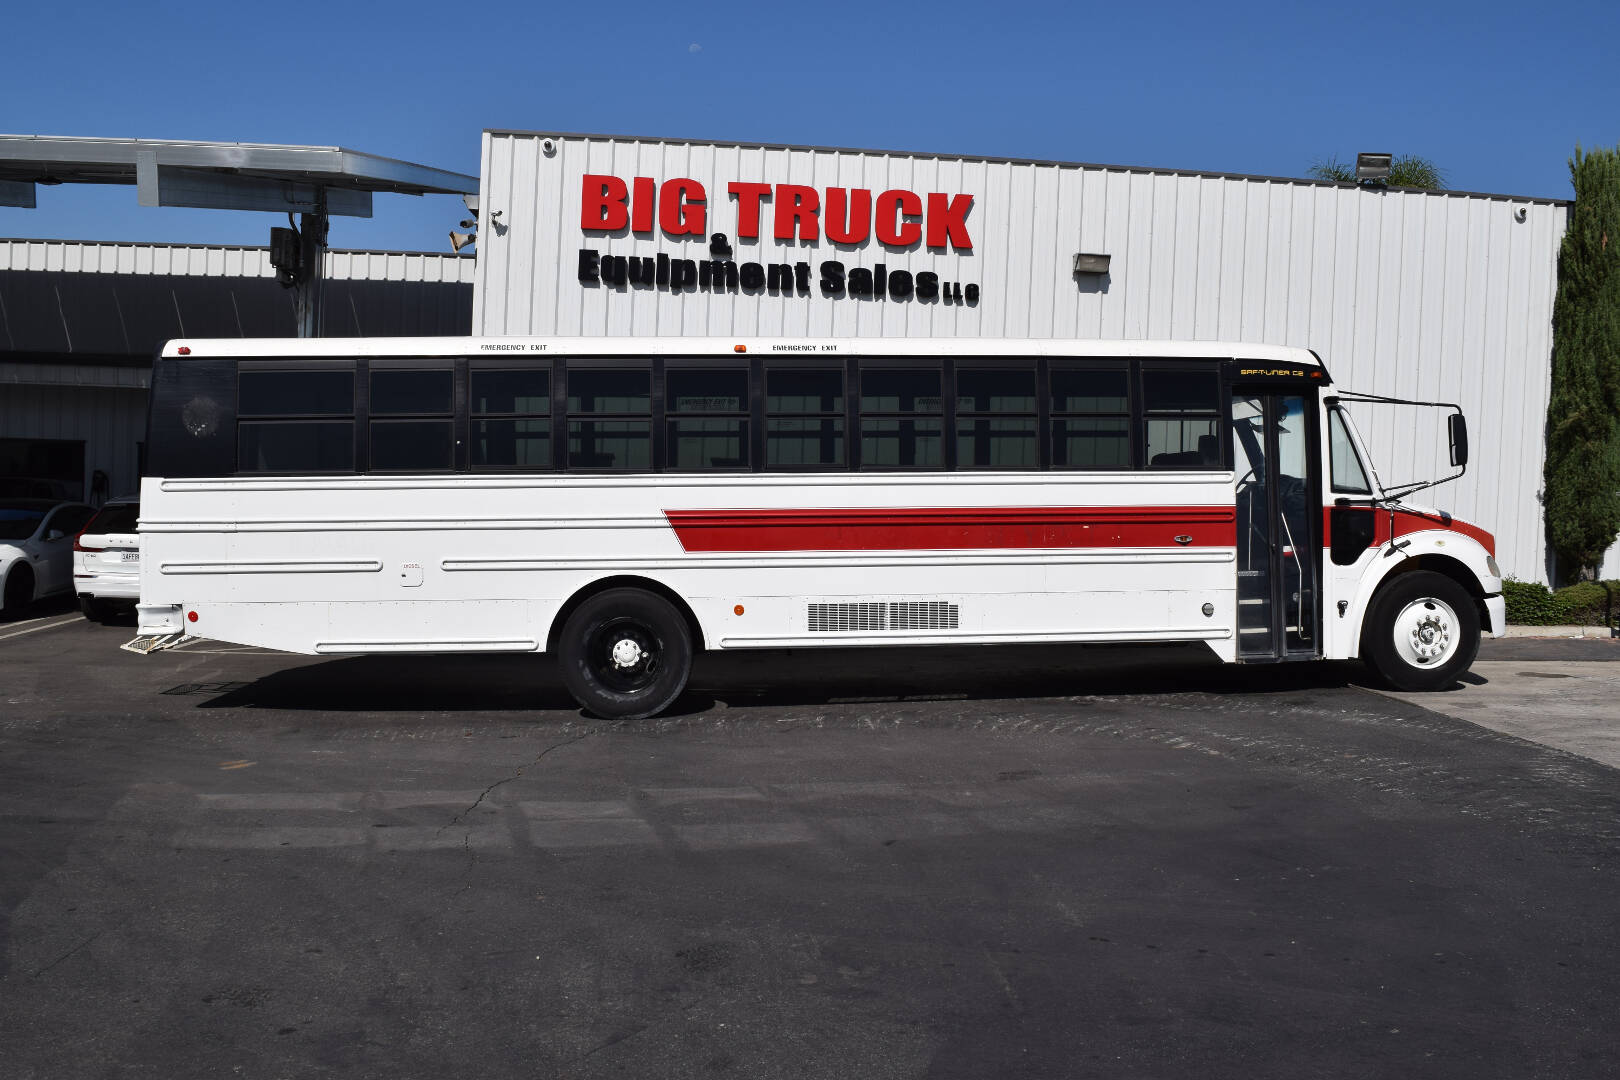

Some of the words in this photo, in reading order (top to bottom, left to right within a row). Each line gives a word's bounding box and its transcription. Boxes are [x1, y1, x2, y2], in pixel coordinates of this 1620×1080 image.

[581, 174, 706, 236] BIG
[727, 181, 974, 249] TRUCK
[709, 232, 733, 255] &
[578, 249, 811, 294] Equipment
[819, 260, 940, 300] Sales
